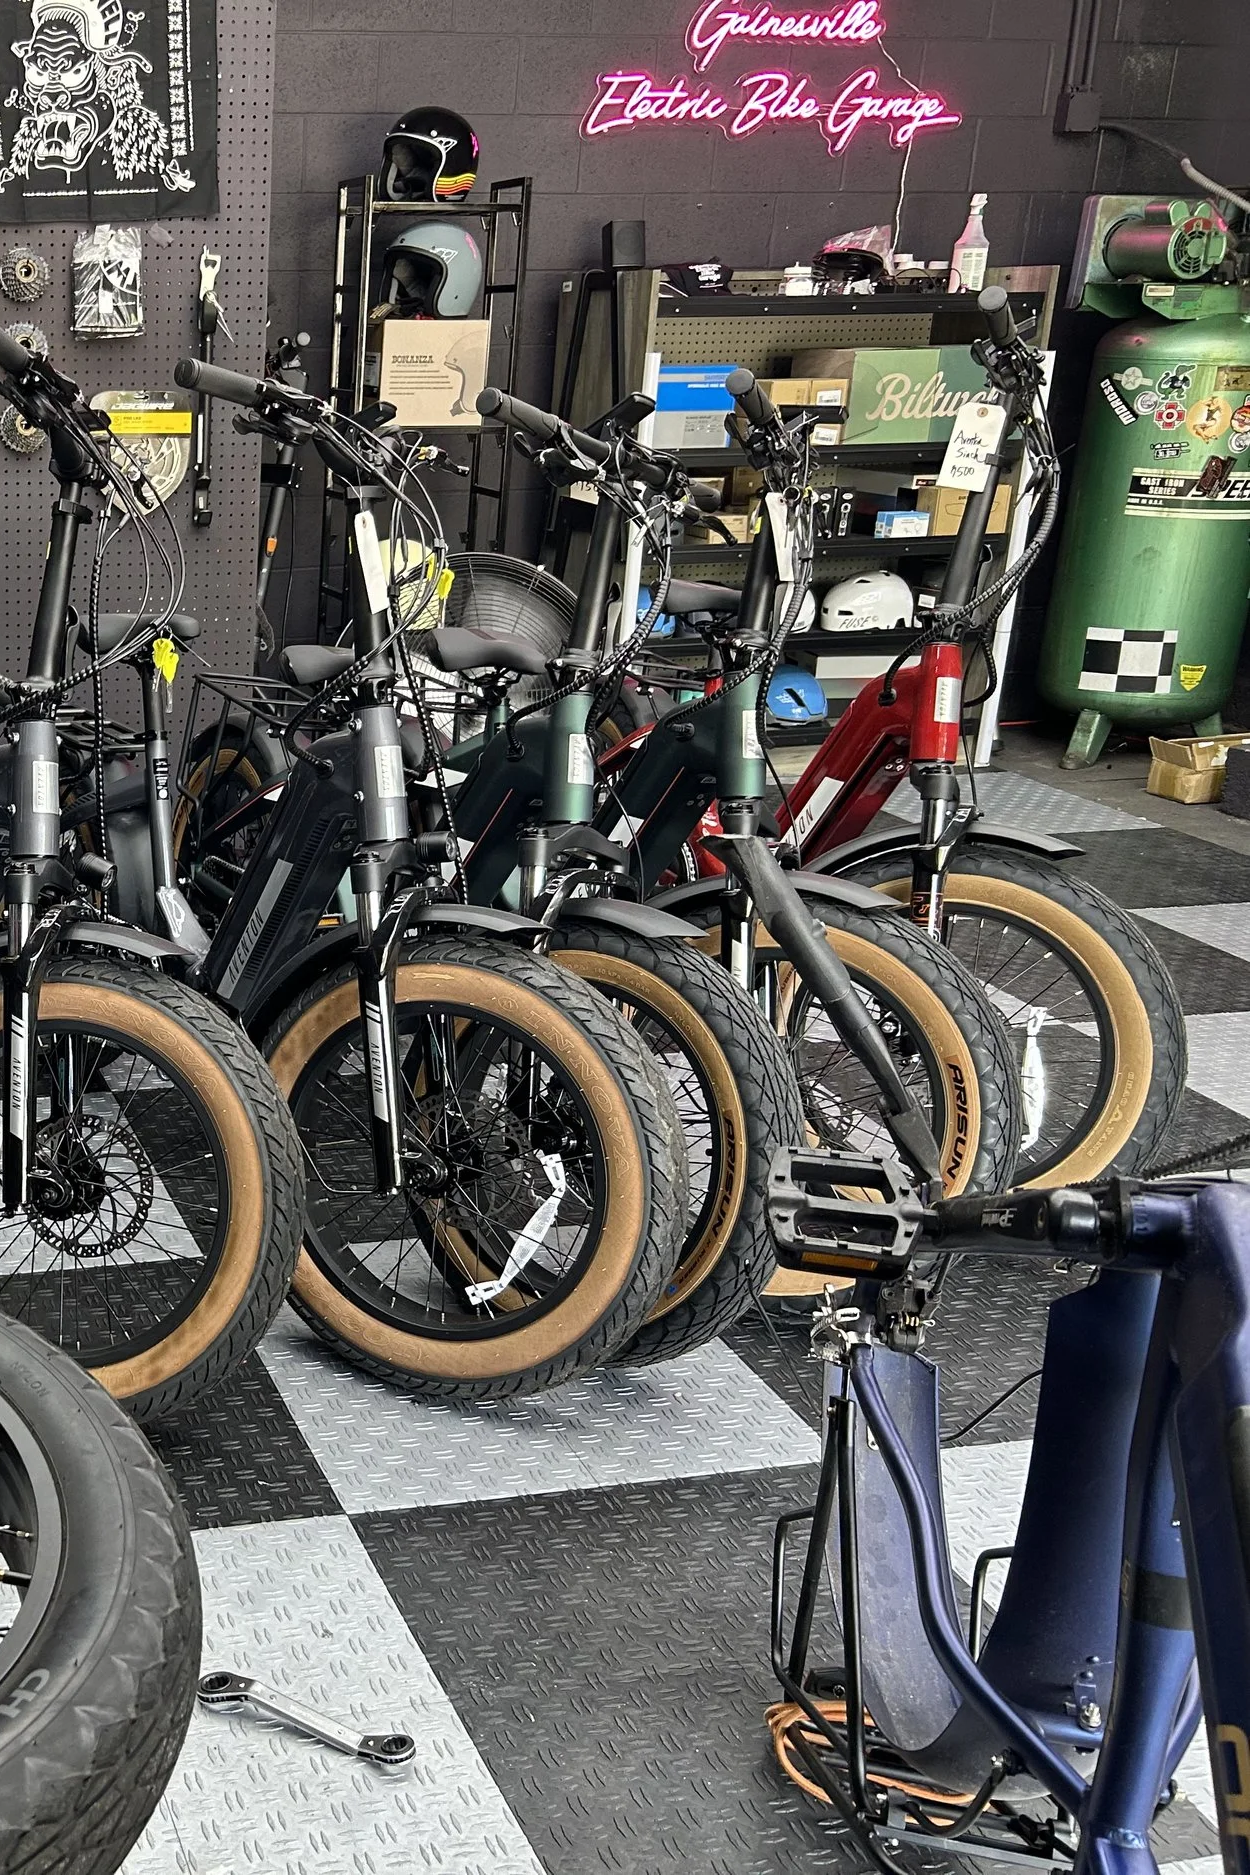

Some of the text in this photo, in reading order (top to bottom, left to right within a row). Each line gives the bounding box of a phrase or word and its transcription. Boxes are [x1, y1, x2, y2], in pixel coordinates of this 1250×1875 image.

[690, 0, 882, 71] Gainesville
[586, 69, 960, 152] Electric Bike Garage
[391, 355, 434, 364] BONANZA
[1140, 478, 1185, 488] CAST IRON
[1149, 487, 1177, 495] SERIES
[839, 616, 871, 629] FUSE
[229, 907, 264, 984] AVENTON
[12, 1057, 22, 1111] AVENTON
[371, 1042, 383, 1095] AVENTON
[523, 1010, 630, 1178] INNOVA
[946, 1062, 969, 1182] ARISUN
[712, 1116, 736, 1238] ARISUN
[10, 1361, 51, 1397] NYLON
